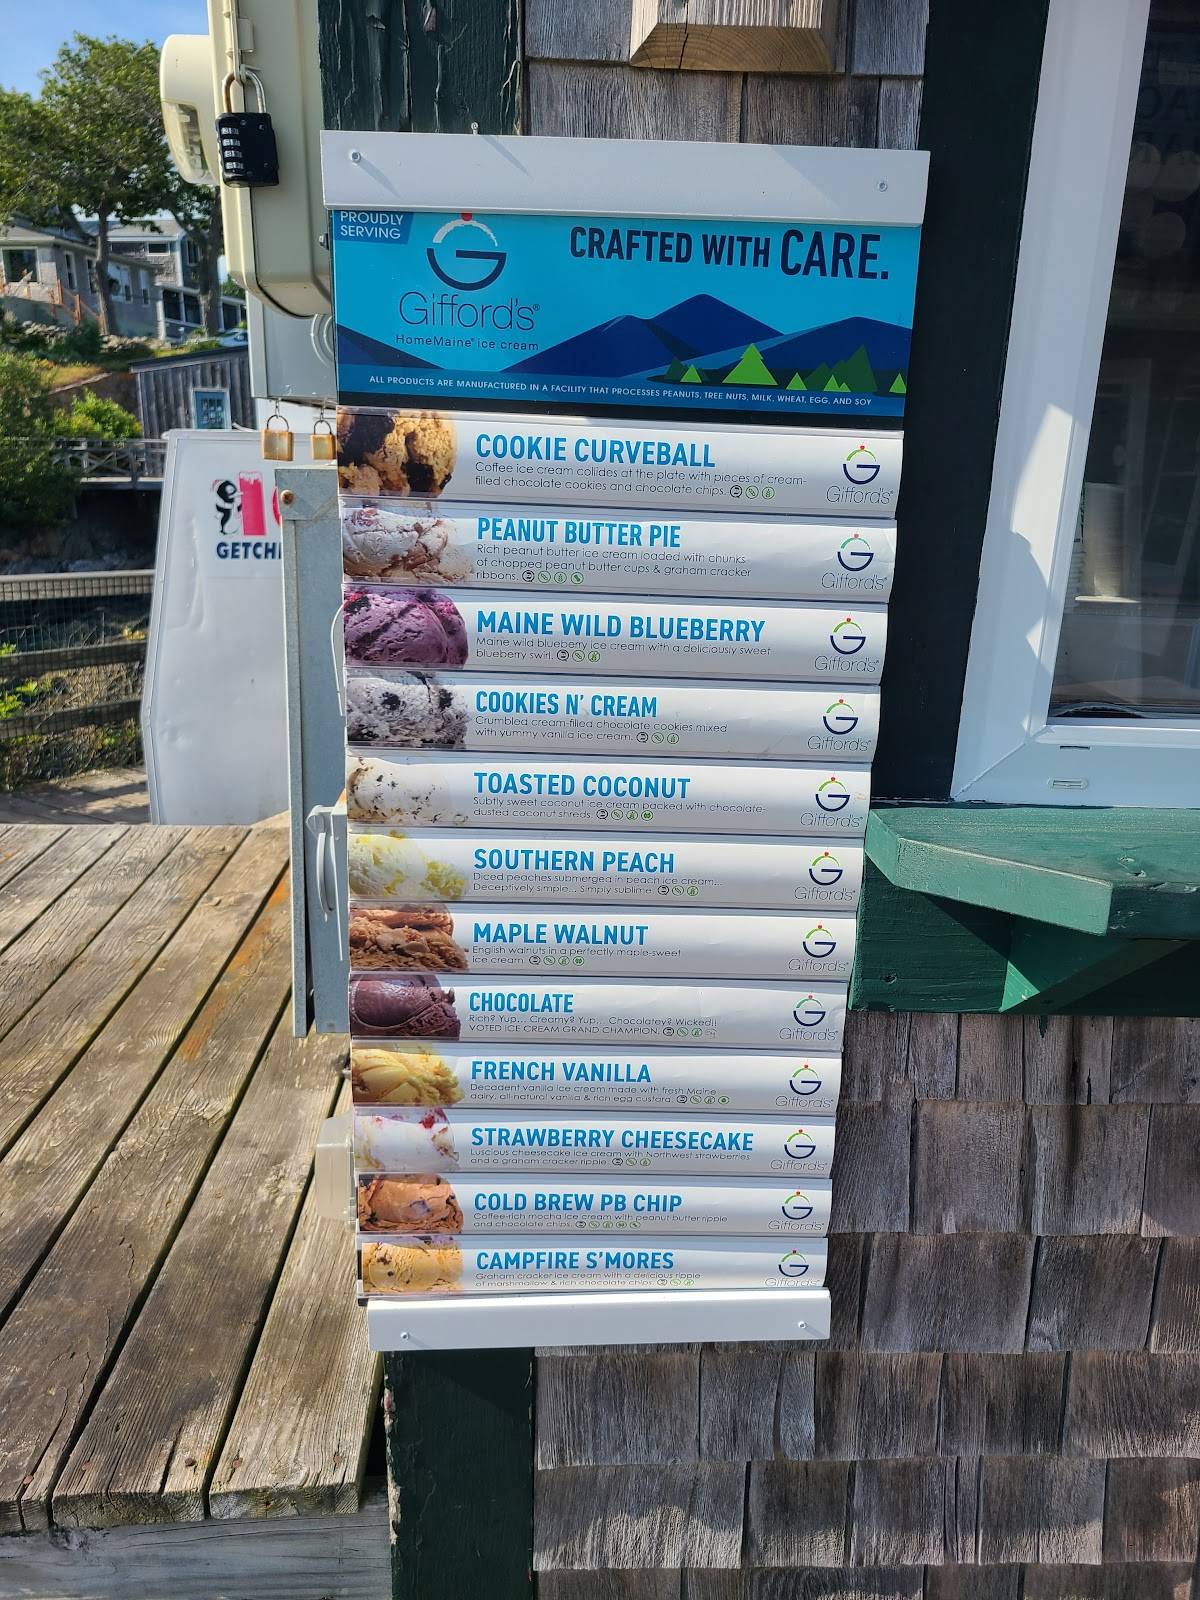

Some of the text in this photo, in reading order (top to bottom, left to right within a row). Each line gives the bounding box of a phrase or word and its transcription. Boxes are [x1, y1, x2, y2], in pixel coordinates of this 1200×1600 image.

[340, 210, 404, 226] PROUDLY
[340, 225, 401, 240] SERVING
[570, 226, 889, 280] CRAFTED WITH CARE.
[477, 338, 495, 349] ice
[500, 342, 539, 351] cream
[370, 376, 384, 384] ALL
[387, 377, 434, 386] PRODUCTS
[437, 379, 454, 387] ARE
[456, 380, 527, 391] MANUFACTURED
[530, 383, 540, 391] IN
[542, 383, 548, 391] A
[551, 384, 587, 393] FACILITY
[589, 386, 609, 394] THAT
[612, 387, 660, 397] PROCESSES
[704, 391, 723, 400] TREE
[833, 397, 852, 405] AND
[854, 398, 872, 406] SOY
[476, 434, 715, 467] COOKIE CURVEBALL
[475, 462, 513, 473] Coffee
[516, 464, 534, 474] ice
[537, 467, 573, 475] cream
[577, 466, 618, 477] collides
[621, 467, 633, 478] at
[635, 468, 653, 478] the
[656, 469, 685, 482] plate
[688, 470, 711, 480] with
[714, 471, 750, 485] pieces
[753, 472, 764, 482] of
[475, 475, 501, 486] filled
[504, 476, 562, 488] chocolate
[565, 479, 607, 490] cookies
[609, 481, 632, 491] and
[635, 481, 692, 493] chocolate
[477, 518, 680, 547] PEANUT BUTTER PIE
[477, 543, 500, 554] Rich
[503, 545, 544, 558] peanut
[546, 546, 580, 557] butter
[582, 548, 599, 558] ice
[602, 551, 638, 559] cream
[683, 552, 705, 562] with
[708, 553, 746, 563] chunks
[476, 557, 752, 578] of chopped peanut butter cups & graham cracker
[477, 611, 765, 641] MAINE WILD BLUEBERRY
[476, 637, 510, 646] Maine
[513, 638, 534, 647] wild
[537, 638, 587, 651] blueberry
[590, 640, 607, 649] ice
[610, 643, 645, 651] cream
[648, 642, 670, 651] with
[739, 645, 771, 655] sweet
[476, 649, 527, 661] blueberry
[476, 691, 657, 717] COOKIES N' CREAM
[475, 715, 728, 732] Crumbled cream-filled chocolate cookies mixed
[475, 727, 496, 737] with
[499, 730, 538, 740] yummy
[577, 730, 594, 739] ice
[474, 772, 691, 798] TOASTED COCONUT
[474, 849, 674, 873] SOUTHERN PEACH
[474, 923, 648, 945] MAPLE WALNUT
[470, 992, 573, 1012] CHOCOLATE
[504, 1025, 520, 1033] ICE
[522, 1025, 560, 1033] CREAM
[562, 1026, 600, 1034] GRAND
[471, 1061, 651, 1082] FRENCH VANILLA
[471, 1128, 753, 1151] STRAWBERRY CHEESECAKE
[475, 1193, 682, 1212] COLD BREW PB CHIP
[477, 1252, 673, 1269] CAMPFIRE S'MORES
